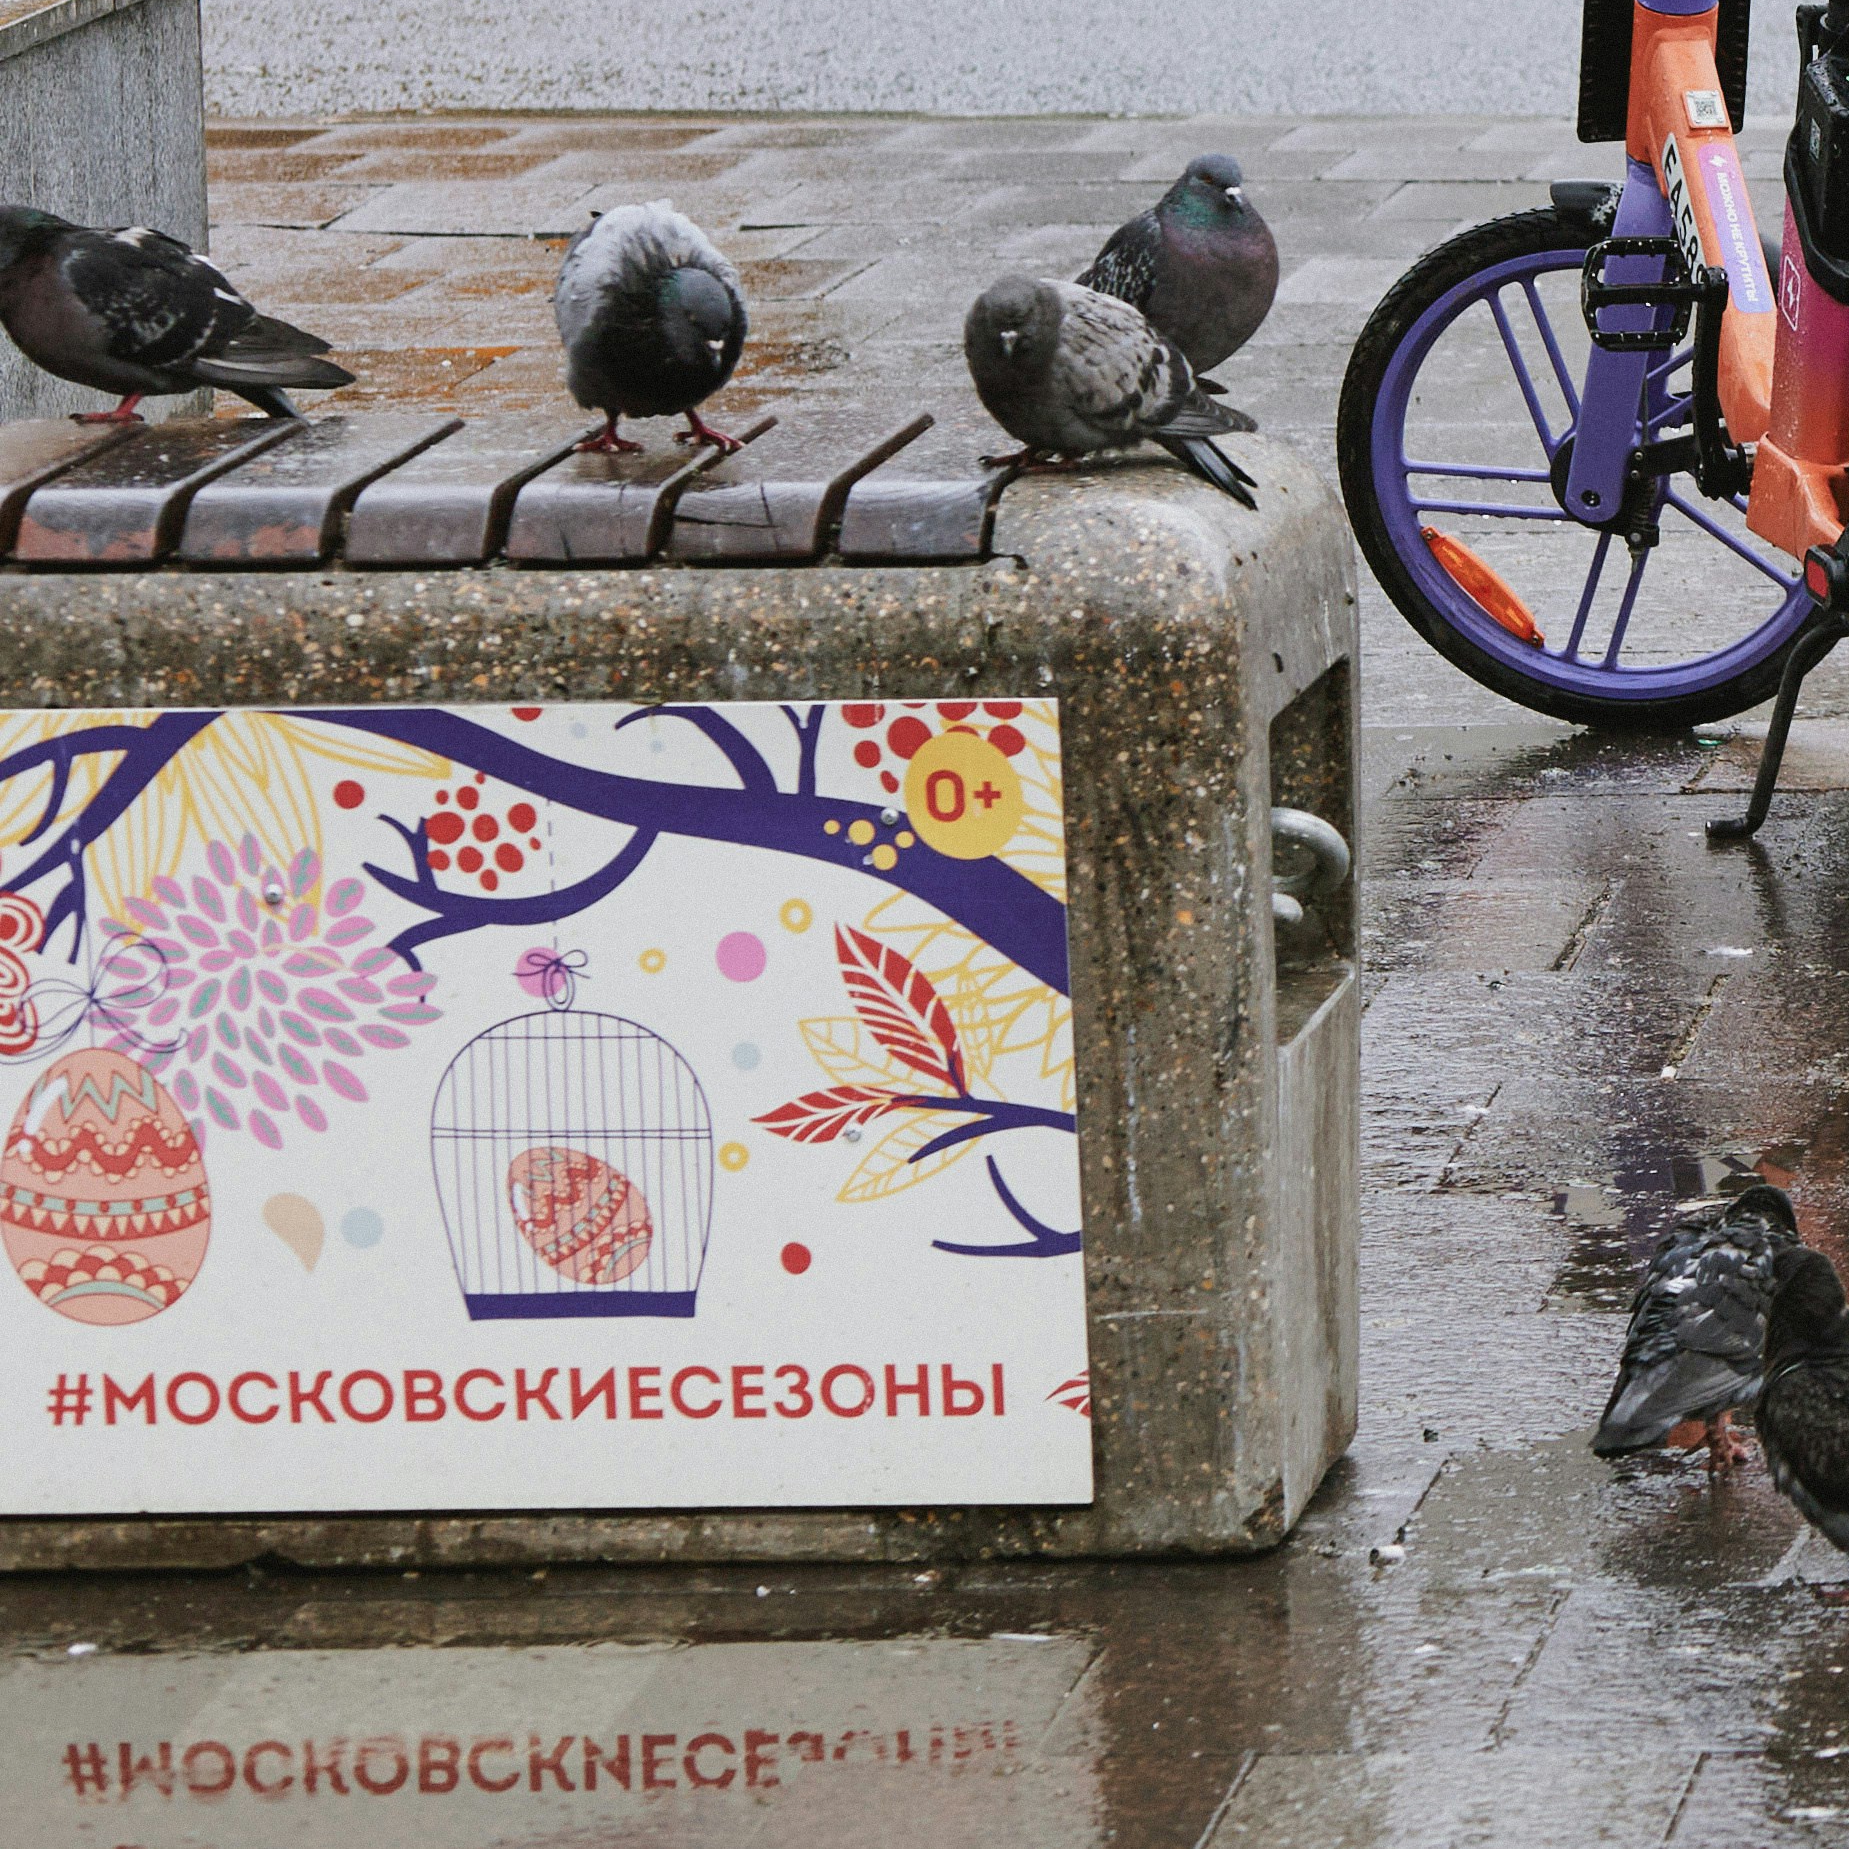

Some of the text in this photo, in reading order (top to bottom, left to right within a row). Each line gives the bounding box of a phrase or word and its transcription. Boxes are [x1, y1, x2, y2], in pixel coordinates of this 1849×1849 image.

[1716, 171, 1739, 224] МОЖНО
[1729, 223, 1744, 241] НЕ
[925, 769, 1003, 823] 0+
[46, 1362, 1008, 1428] #МОСКОВСКИЕСЕЗОНЫ
